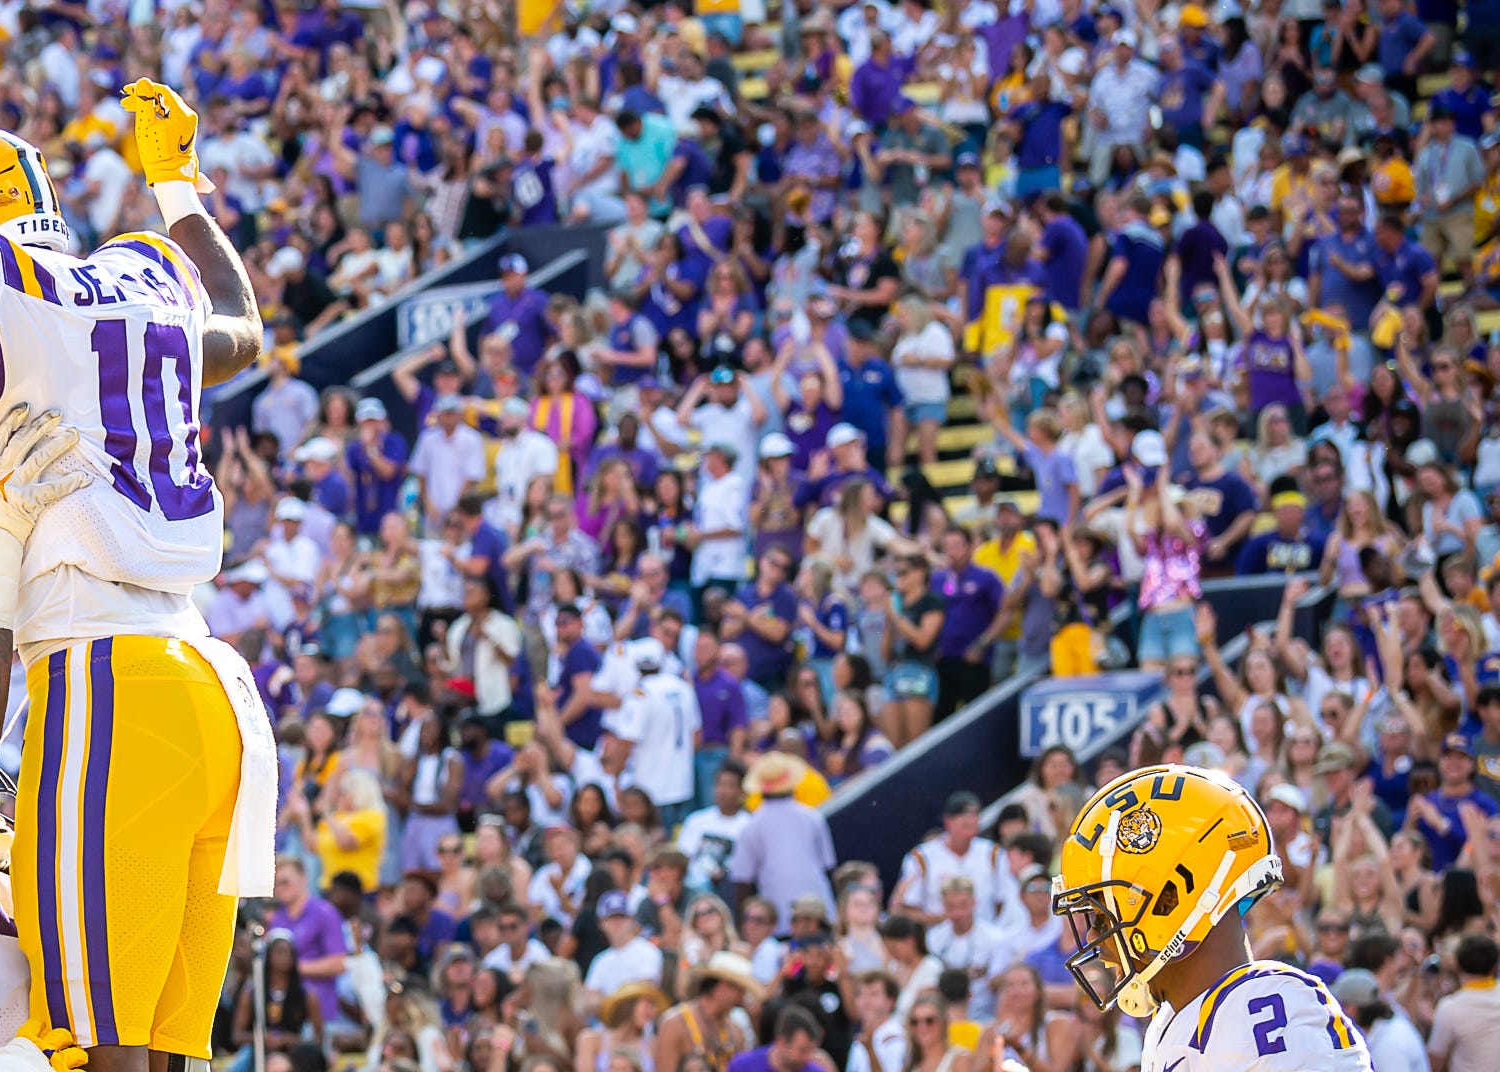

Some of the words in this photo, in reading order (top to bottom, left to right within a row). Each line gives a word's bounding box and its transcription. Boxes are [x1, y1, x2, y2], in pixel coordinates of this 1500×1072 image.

[91, 319, 215, 521] 10
[1037, 696, 1119, 750] 105
[1075, 776, 1186, 851] LSU
[1159, 929, 1187, 963] schutt
[1247, 992, 1288, 1057] 2
